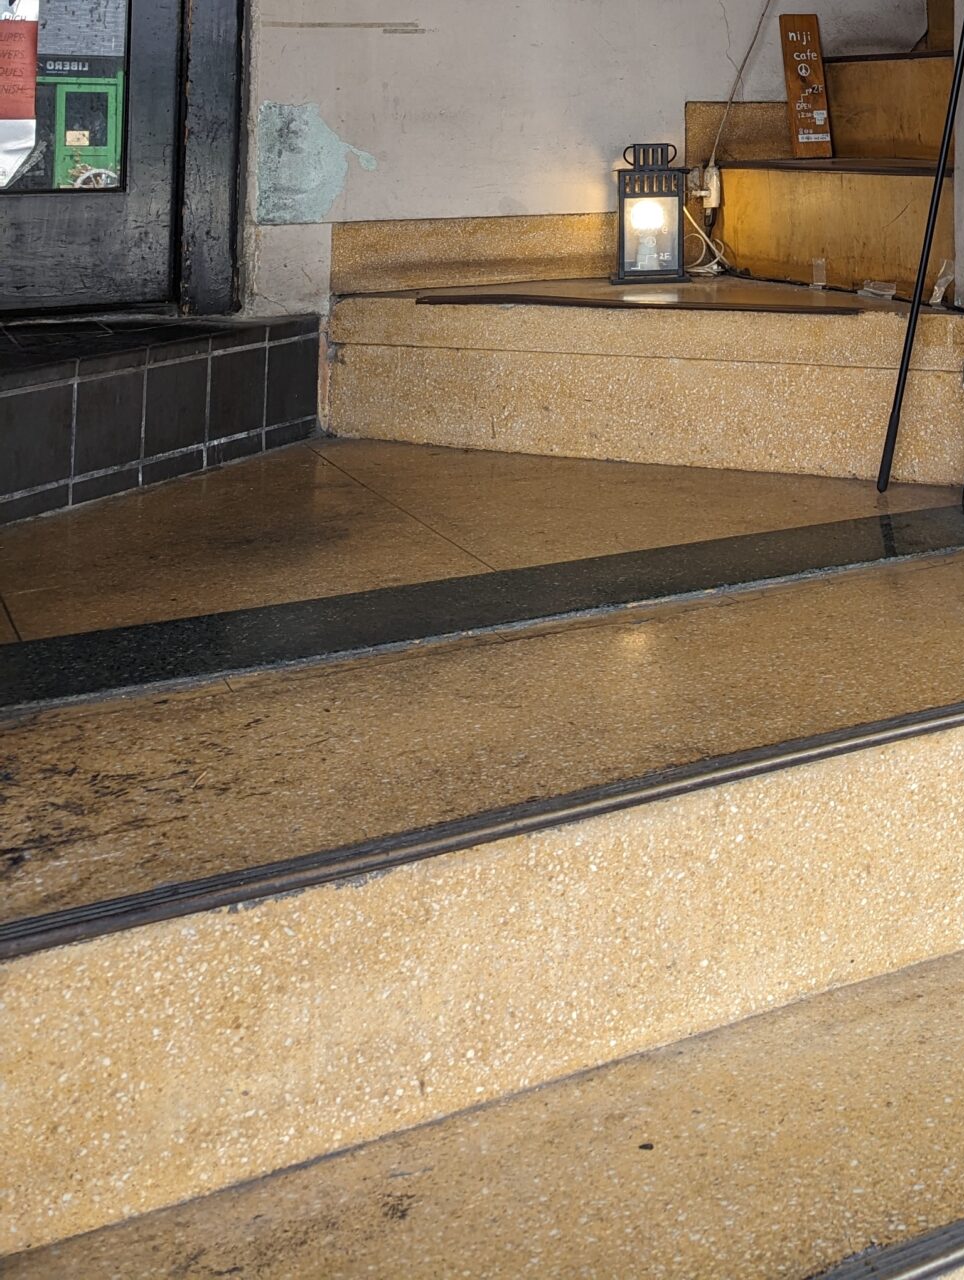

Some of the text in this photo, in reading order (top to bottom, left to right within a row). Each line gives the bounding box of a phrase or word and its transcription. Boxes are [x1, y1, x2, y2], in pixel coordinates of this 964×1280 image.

[788, 31, 811, 45] niji
[793, 48, 818, 61] cafe
[812, 84, 824, 94] 2F
